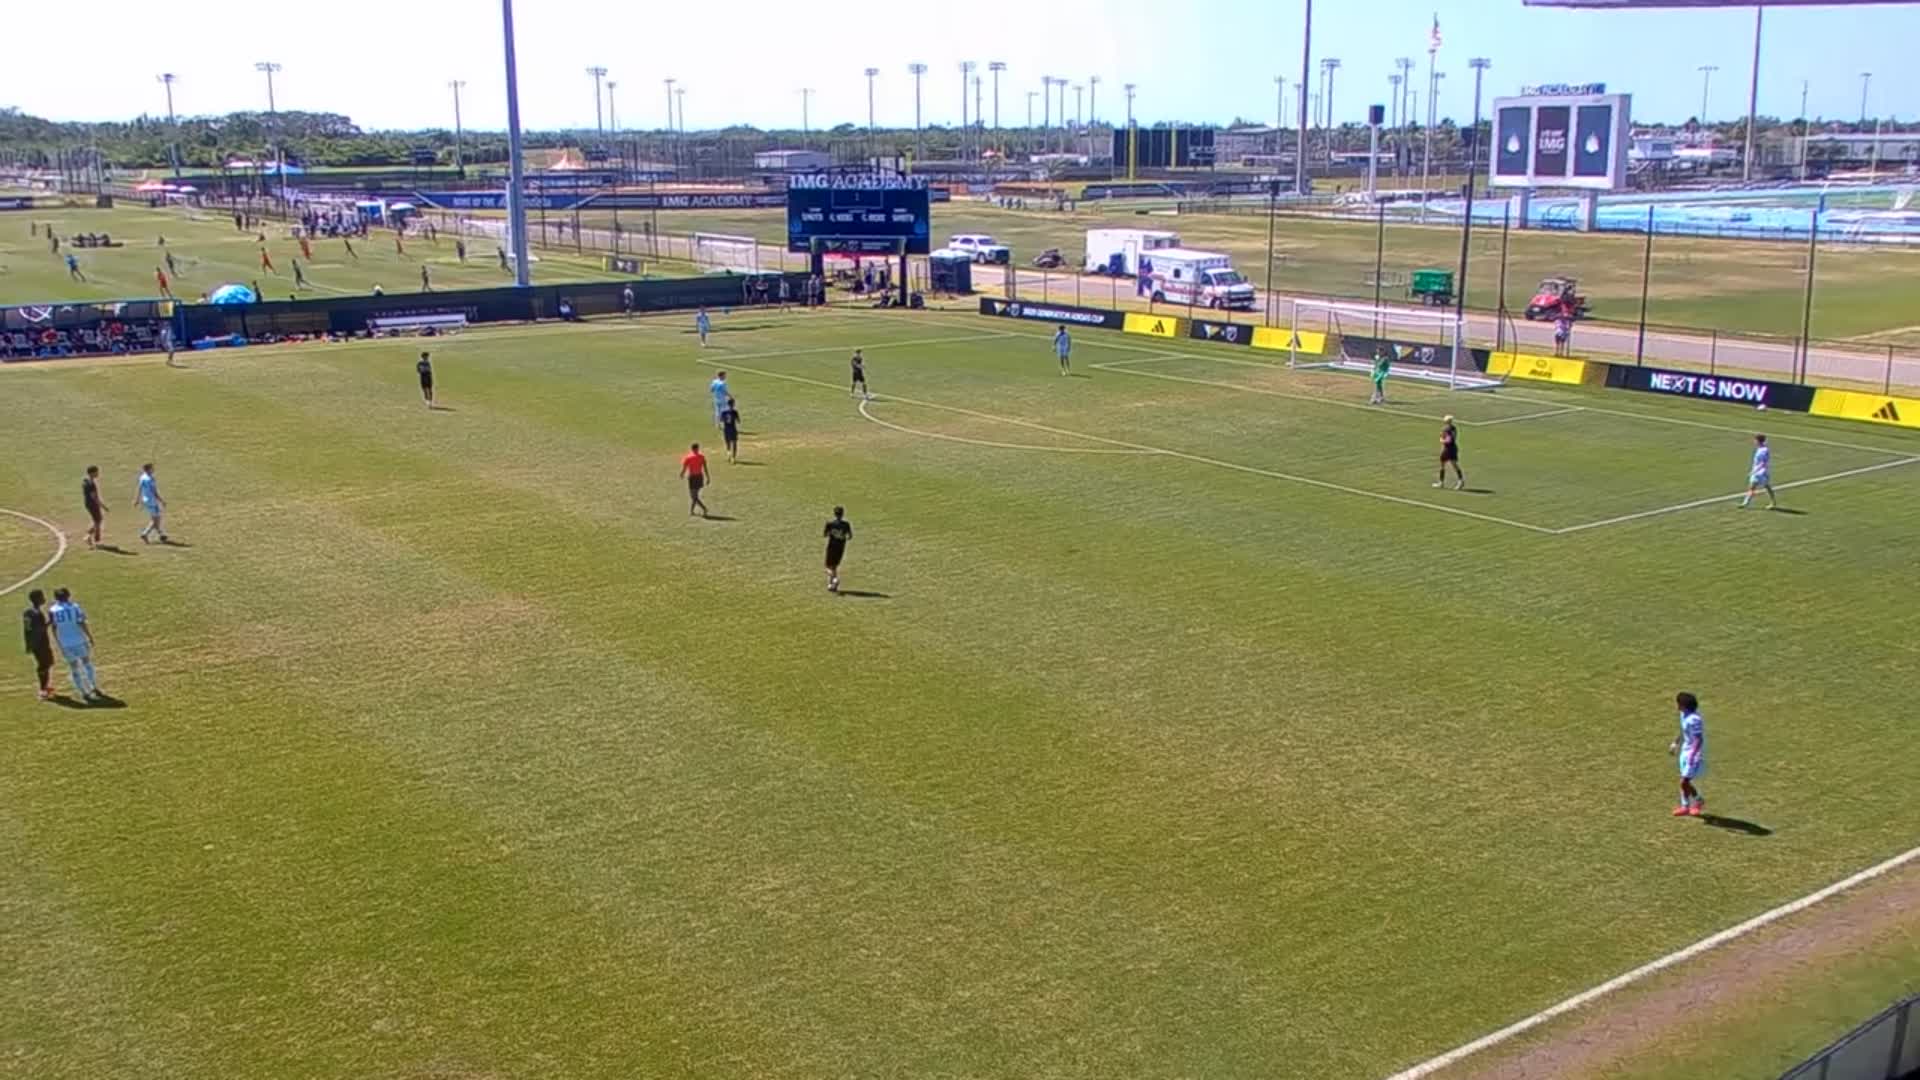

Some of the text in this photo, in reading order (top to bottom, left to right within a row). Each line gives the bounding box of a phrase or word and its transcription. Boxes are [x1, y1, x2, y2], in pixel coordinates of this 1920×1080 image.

[1539, 138, 1565, 149] IMG
[790, 173, 925, 189] IMG ACADEMY
[662, 195, 751, 207] IMG ACADEMY
[1650, 372, 1767, 401] NEXT IS NOW
